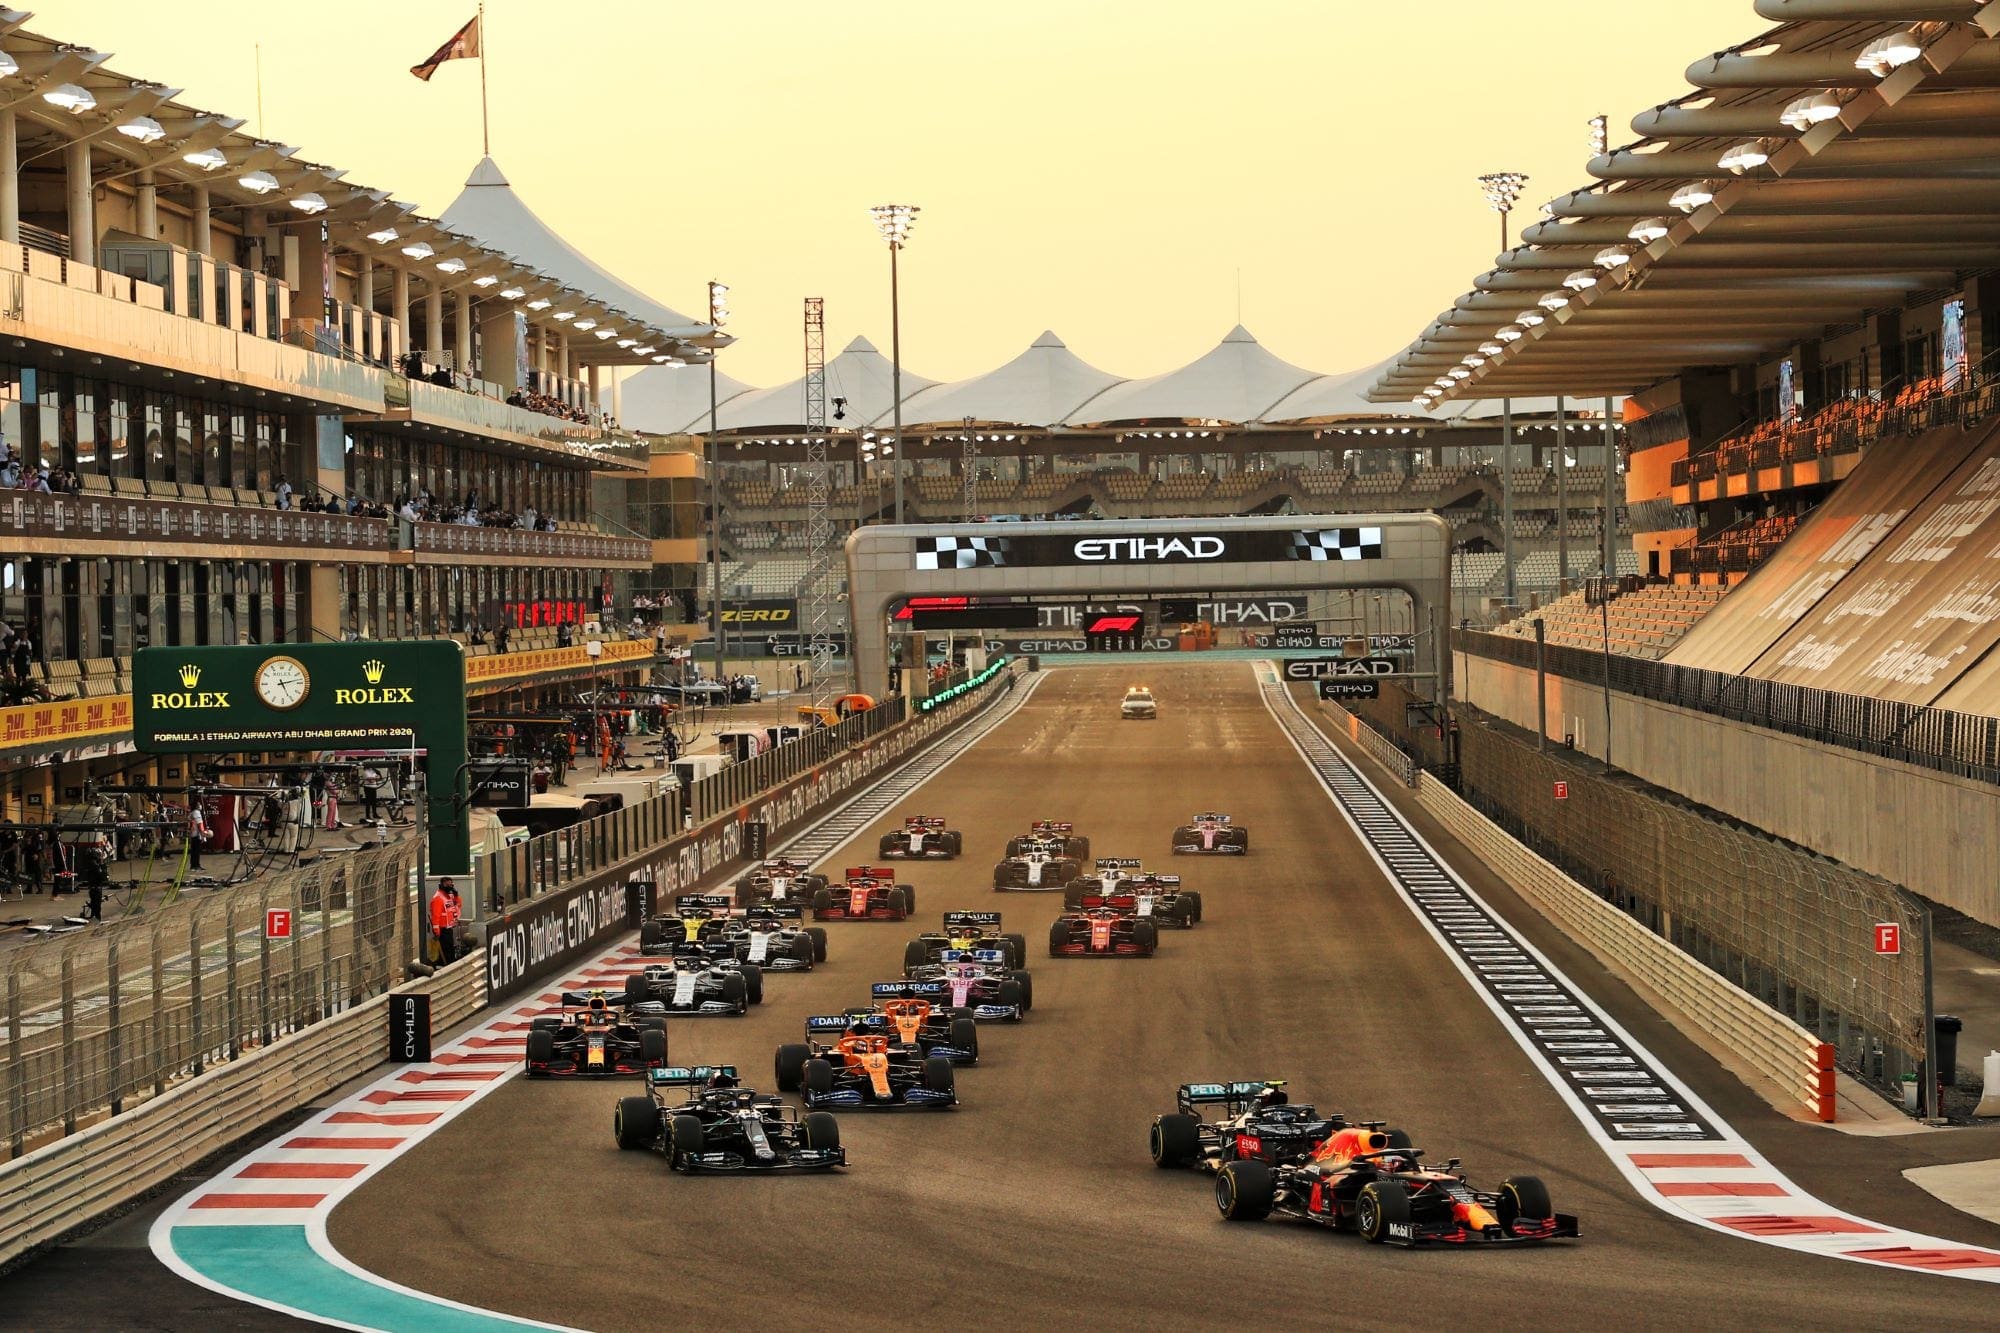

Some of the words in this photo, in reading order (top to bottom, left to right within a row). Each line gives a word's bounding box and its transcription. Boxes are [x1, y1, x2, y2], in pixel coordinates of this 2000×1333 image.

[1074, 537, 1225, 560] ETIHAD
[721, 610, 791, 622] ZERO
[1197, 601, 1296, 625] TIHAD
[1020, 641, 1087, 651] ETIHAD
[1320, 637, 1346, 647] ETIHA
[1288, 662, 1394, 677] ETIHAD
[335, 688, 414, 704] ROLEX
[1326, 685, 1373, 693] ETIHAD
[152, 693, 231, 709] ROLEX
[154, 733, 199, 742] FORMULA
[200, 733, 206, 741] 1
[207, 732, 240, 740] ETIHAD
[241, 731, 283, 739] AIRWAYS
[284, 730, 304, 738] ABU
[305, 730, 333, 738] DHABI
[334, 729, 367, 737] GRAND
[368, 728, 388, 736] PRIX
[389, 728, 413, 736] 2020
[1558, 785, 1564, 796] F
[274, 914, 285, 934] F
[490, 922, 526, 990] ETIHAD
[567, 889, 596, 948] ETIHAD
[1881, 928, 1893, 950] F
[405, 998, 415, 1058] ETIHAD
[1390, 1223, 1408, 1238] Mobil
